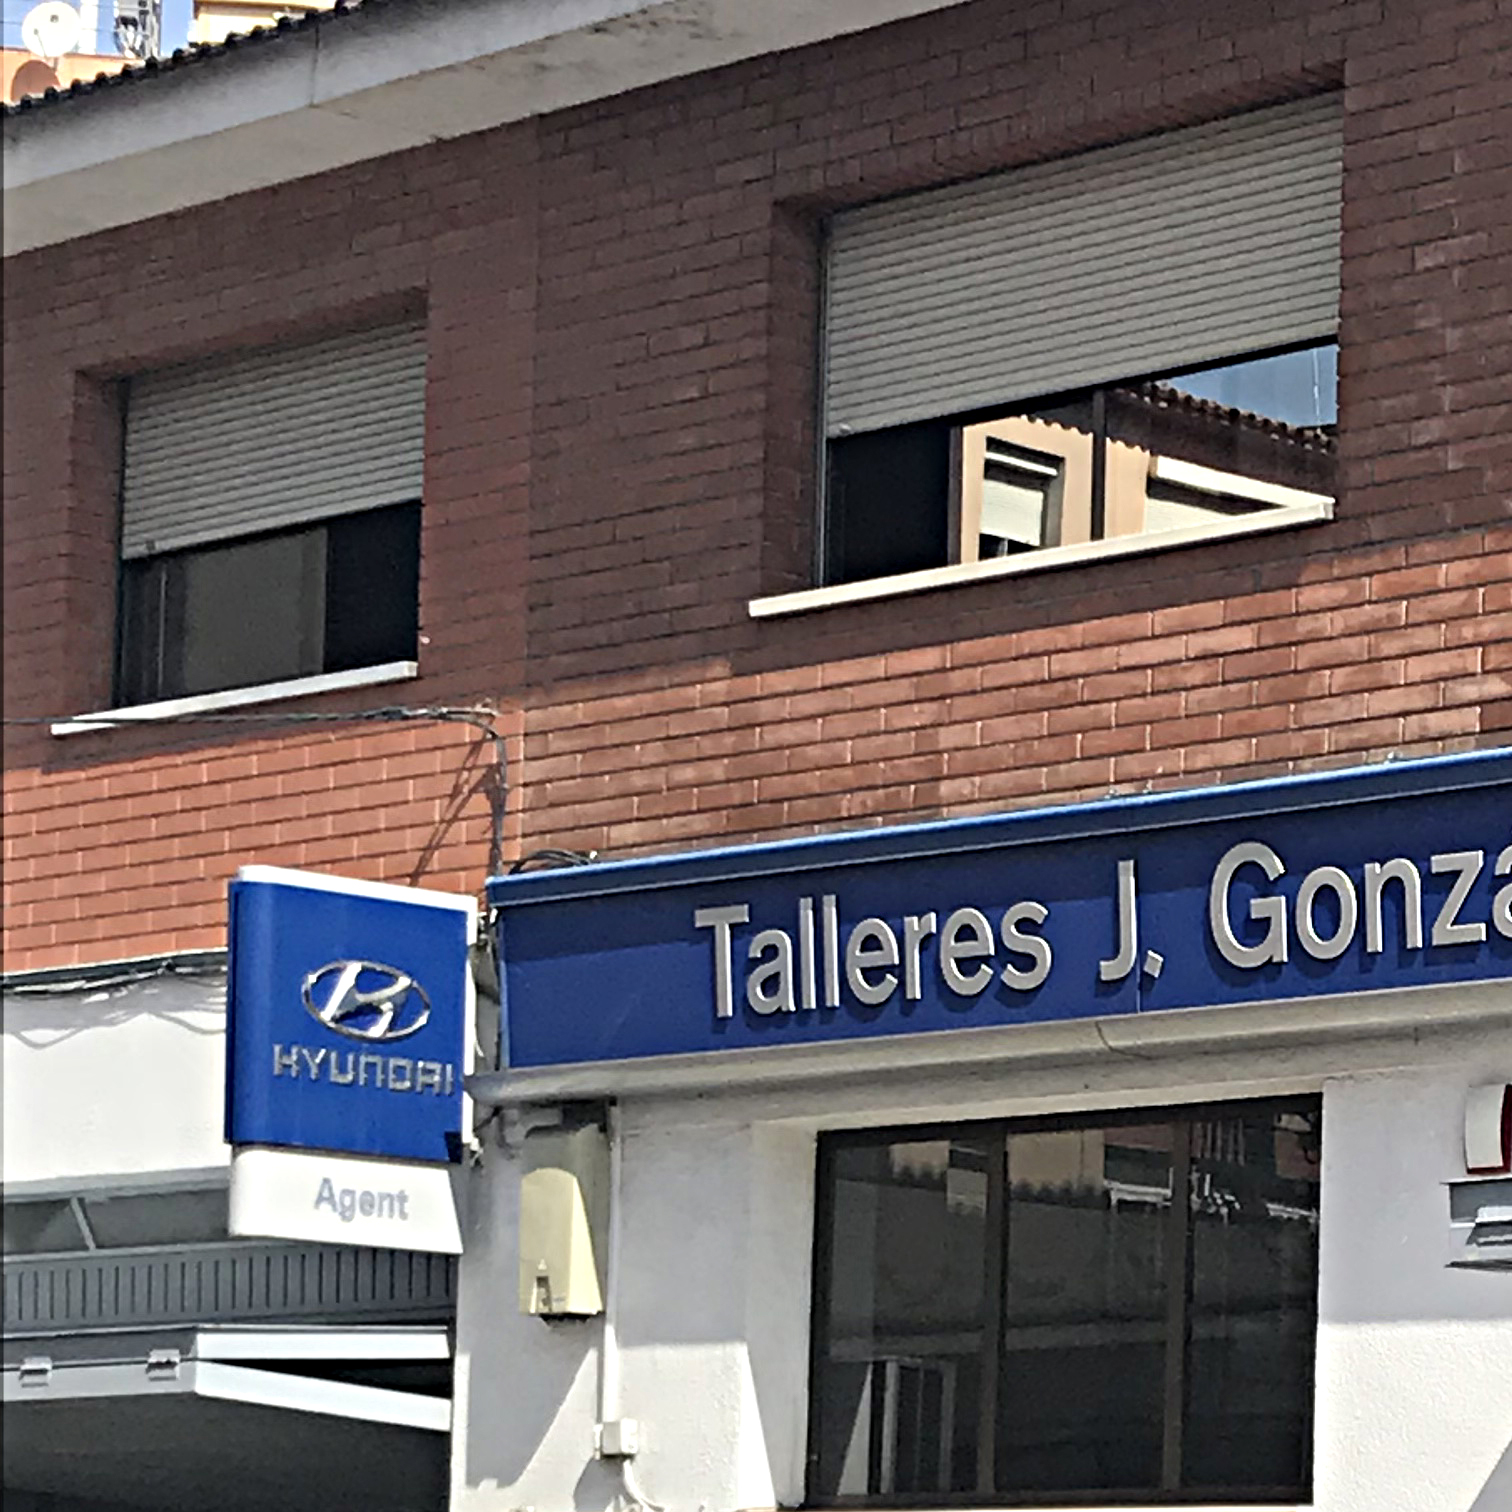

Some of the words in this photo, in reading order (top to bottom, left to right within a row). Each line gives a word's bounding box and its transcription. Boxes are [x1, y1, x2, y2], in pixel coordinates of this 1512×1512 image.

[693, 891, 1053, 1019] Talleres
[1098, 859, 1165, 983] J.
[273, 1043, 454, 1097] HYUNDAI
[314, 1177, 409, 1222] Agent
